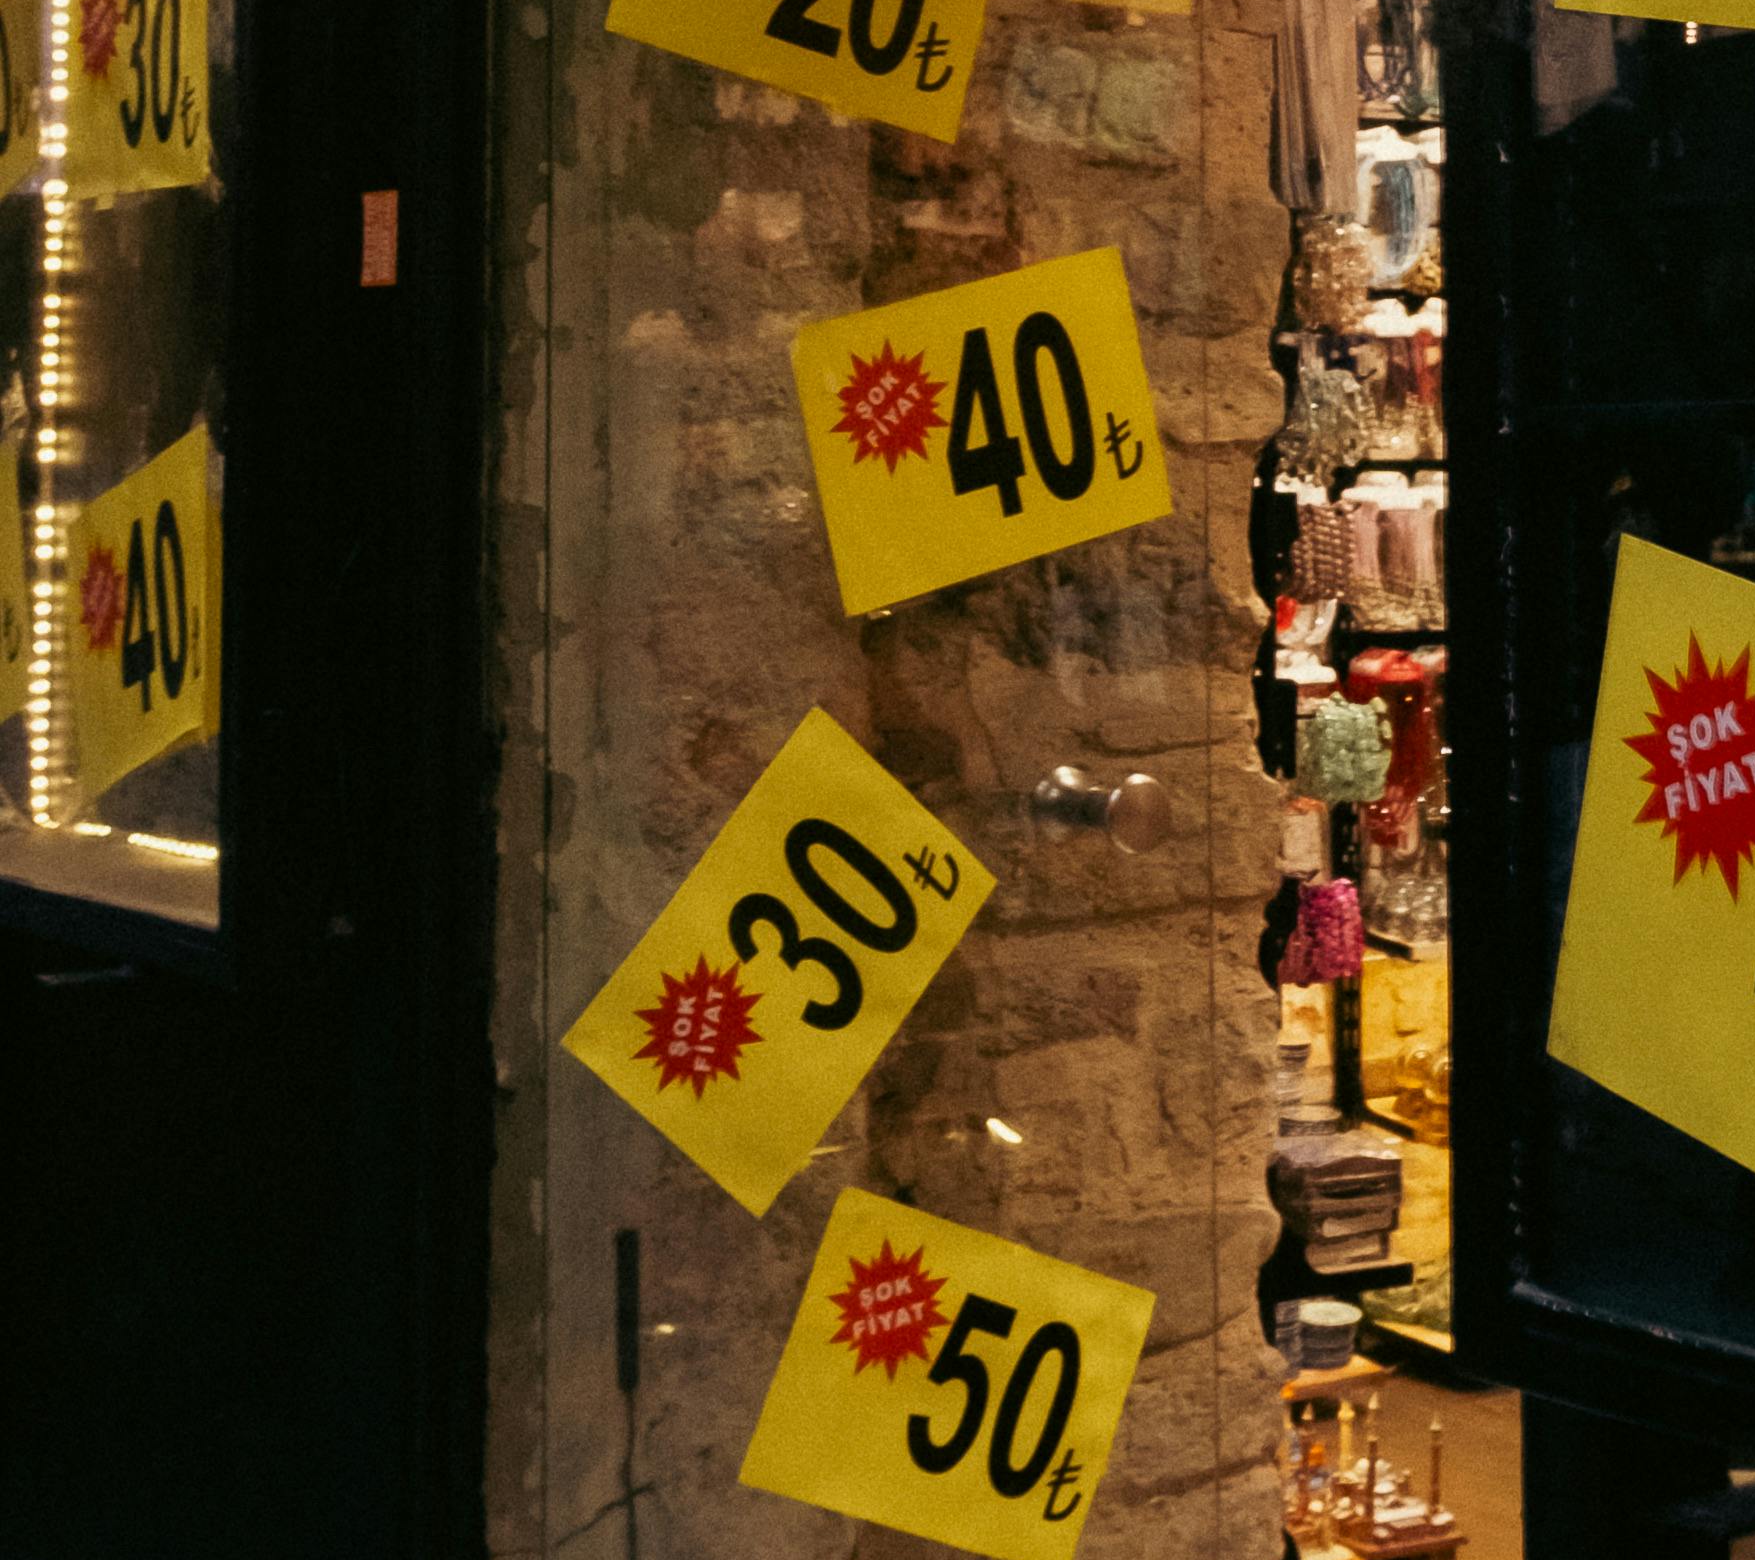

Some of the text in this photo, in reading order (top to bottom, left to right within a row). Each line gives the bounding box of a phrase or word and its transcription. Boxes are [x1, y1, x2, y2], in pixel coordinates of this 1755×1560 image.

[948, 311, 1143, 518] 40₺
[1666, 700, 1746, 768] ŞOK
[728, 818, 960, 1031] 30₺
[907, 1293, 1082, 1521] 50₺
